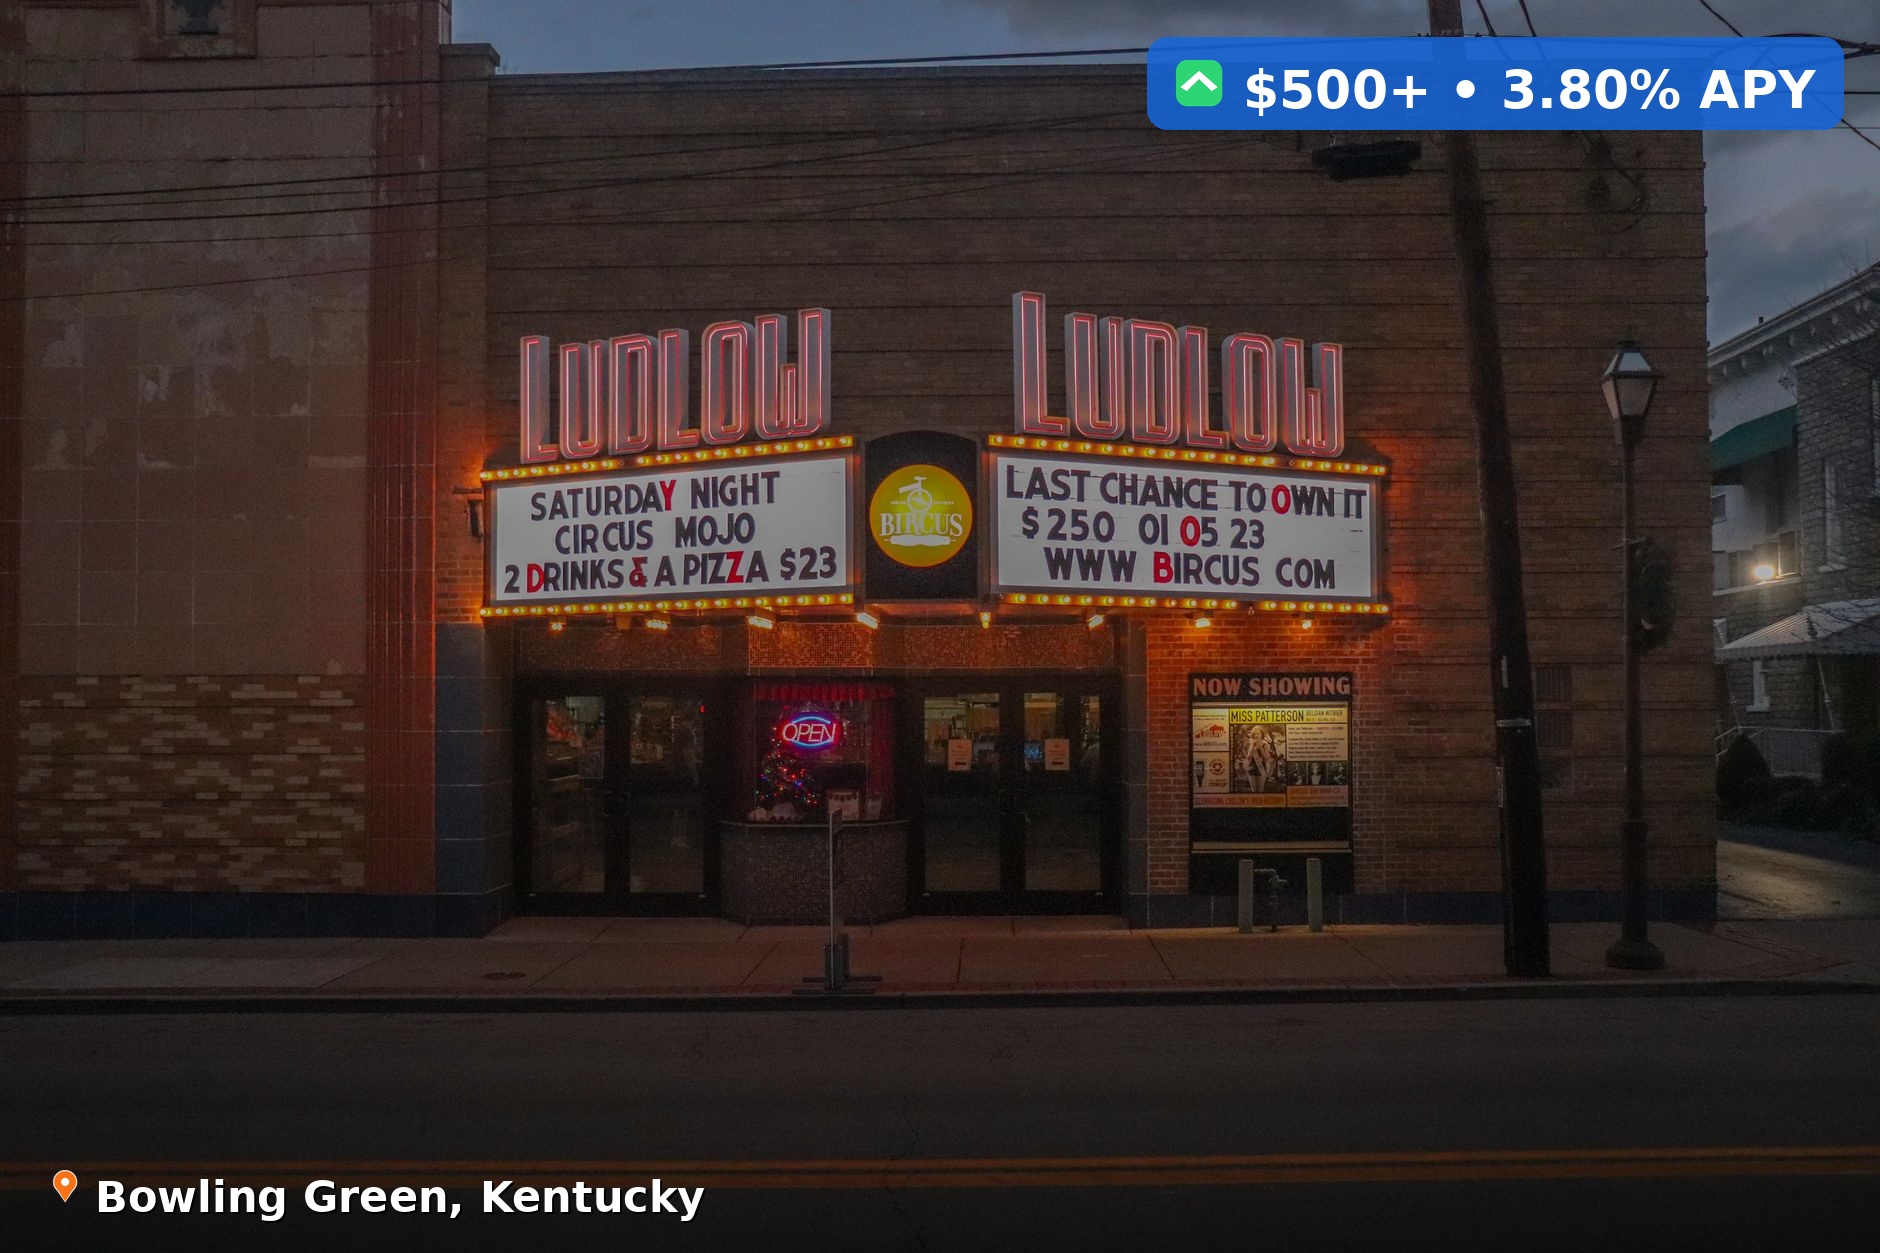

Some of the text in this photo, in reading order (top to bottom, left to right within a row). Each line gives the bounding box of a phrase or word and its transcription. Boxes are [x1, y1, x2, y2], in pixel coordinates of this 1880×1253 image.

[520, 307, 832, 464] LUDLOW
[1012, 291, 1345, 457] LUDLOW
[531, 471, 780, 521] SATURDAY NIGHT
[1006, 464, 1367, 519] LAST CHANCE TO OWN IT
[554, 512, 756, 555] CIRCUS MOJO
[880, 512, 963, 537] BIRCUS
[1180, 515, 1219, 548] 05
[1230, 518, 1265, 550] 23
[504, 546, 837, 594] 2 DRINKS & A PIZZA $23
[1043, 547, 1336, 590] WWW BIRCUS COM
[1193, 677, 1350, 696] NOW SHOWING
[782, 723, 837, 743] OPEN
[1231, 710, 1253, 722] MISS
[1255, 710, 1304, 722] PATTERSON
